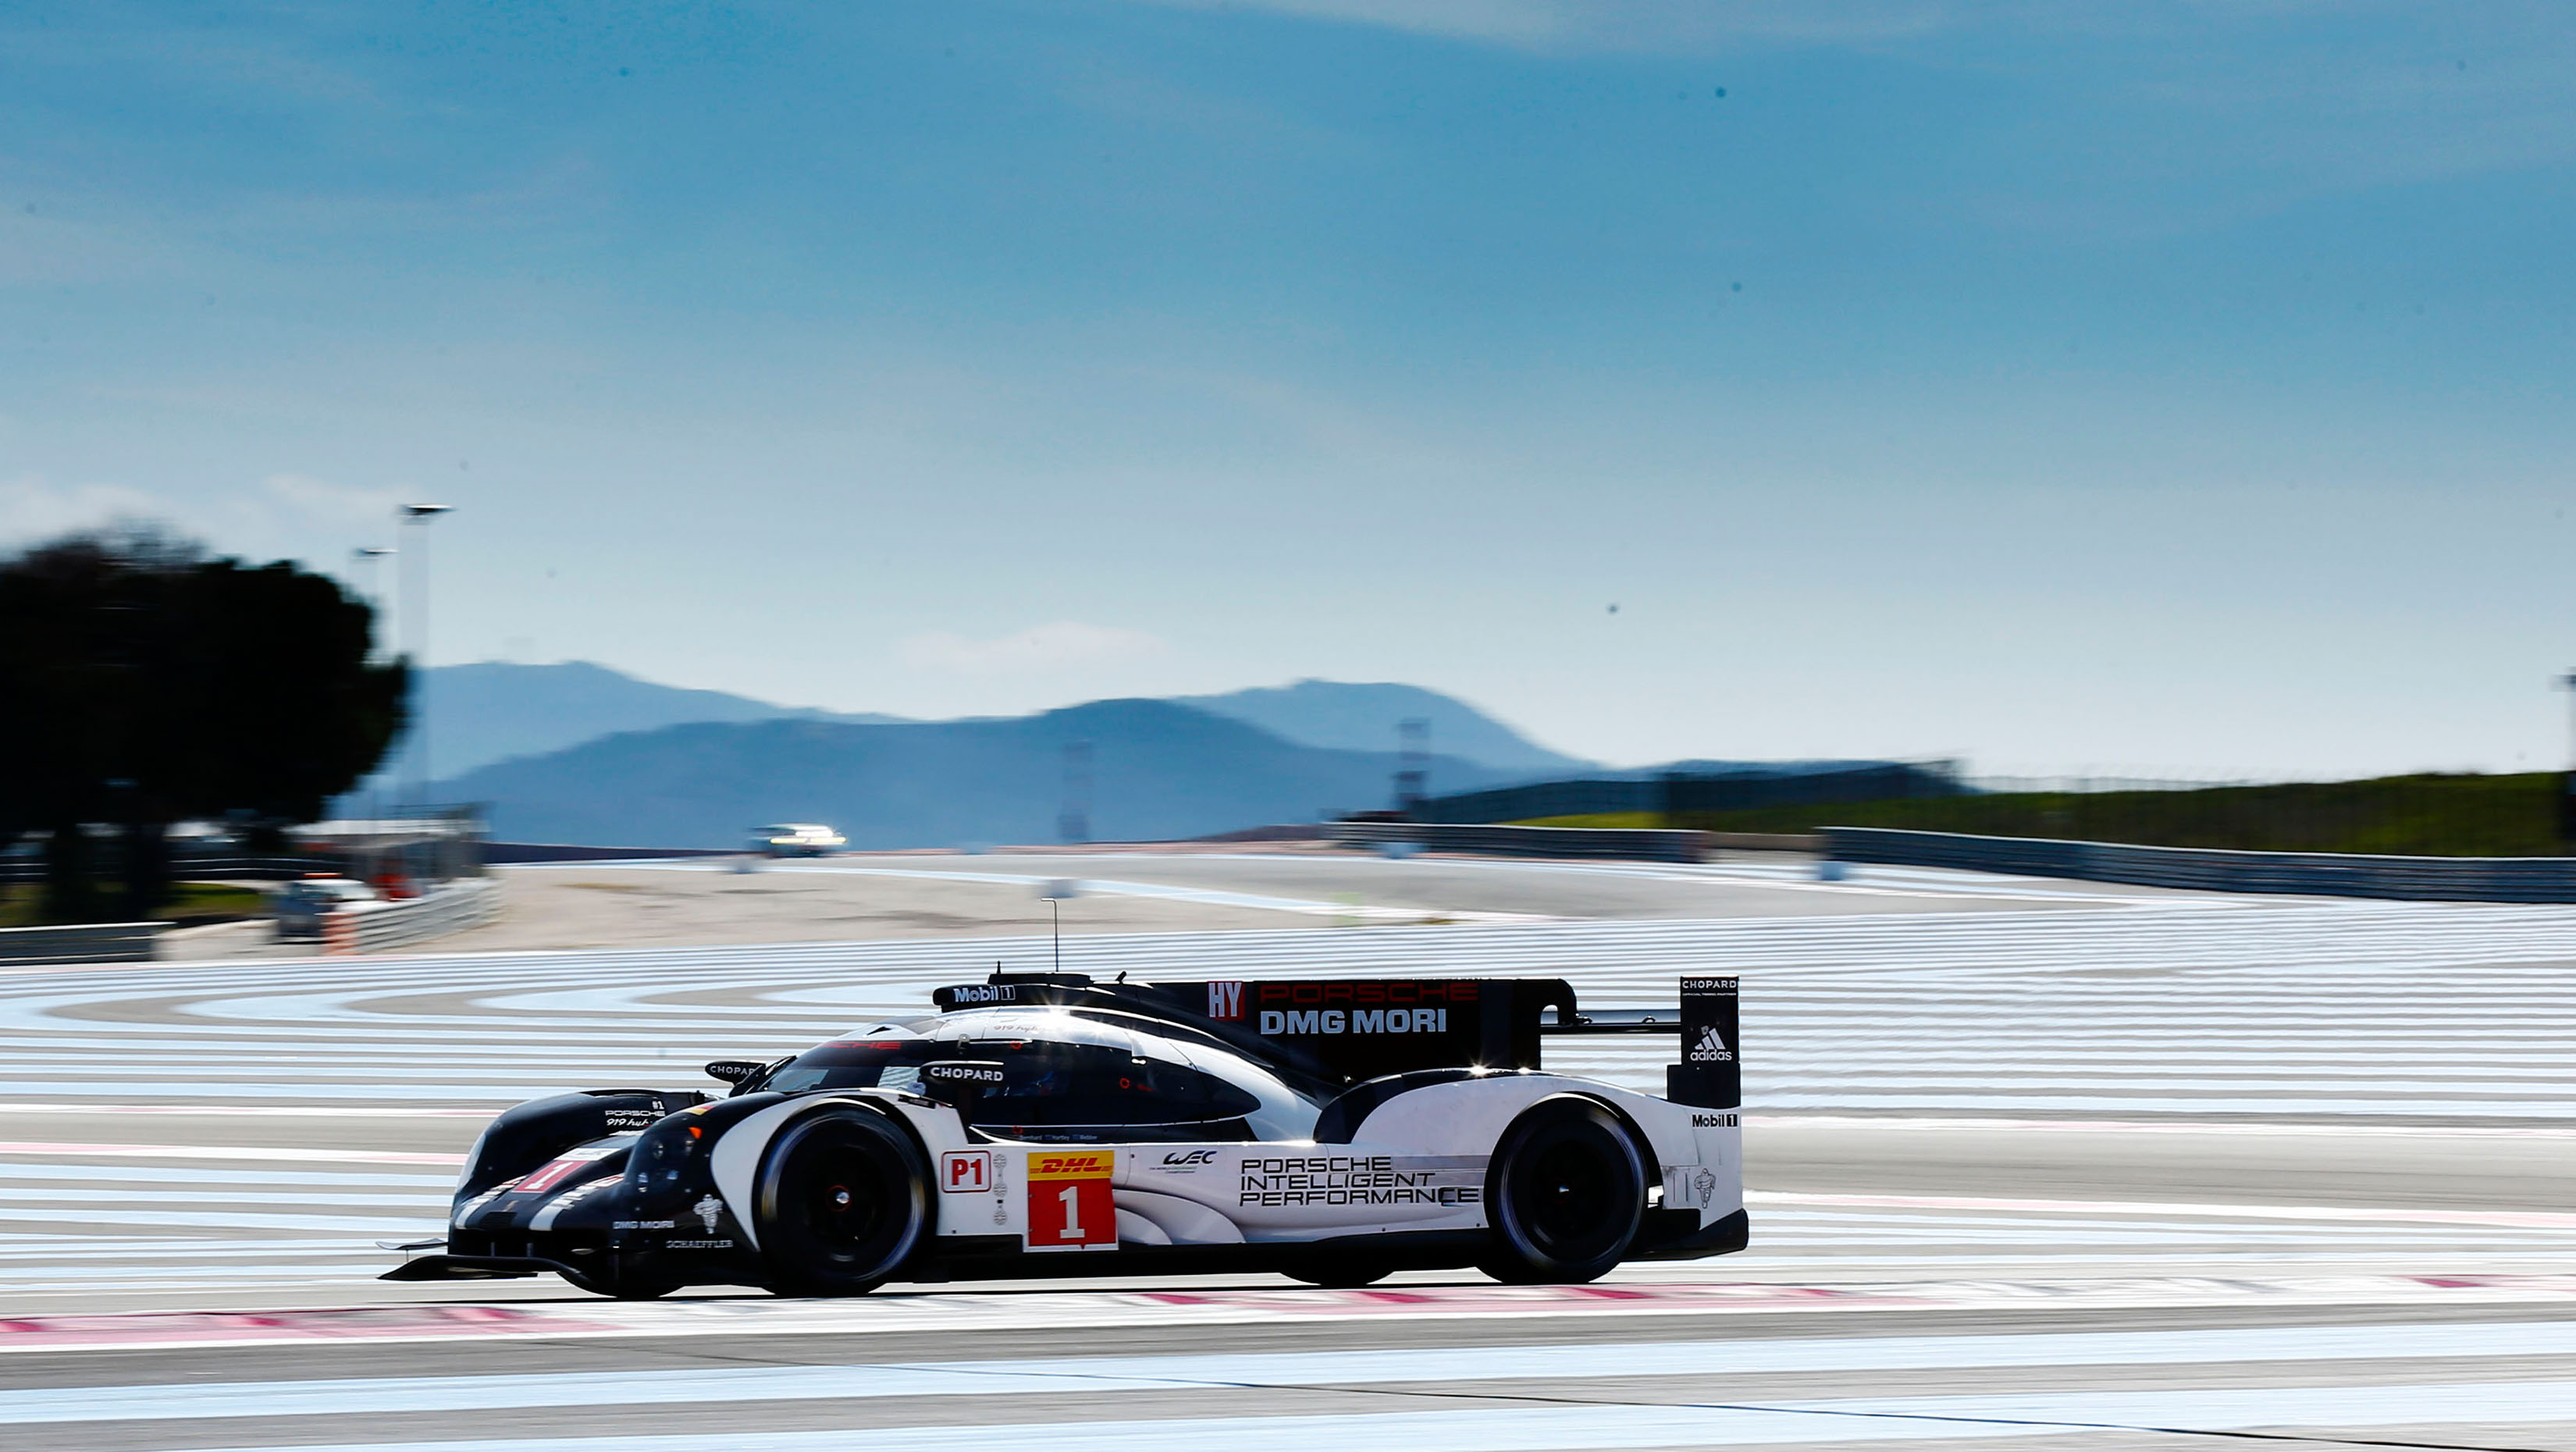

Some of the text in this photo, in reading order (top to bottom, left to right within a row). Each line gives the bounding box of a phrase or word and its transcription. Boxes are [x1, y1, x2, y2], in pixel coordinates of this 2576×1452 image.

[1682, 980, 1737, 989] CHOPARD
[953, 986, 999, 1002] Mobil
[1208, 982, 1242, 1018] HY
[1260, 983, 1479, 1004] PORSCHE
[1261, 1009, 1447, 1035] DMG MORI
[1690, 1048, 1732, 1062] adidas
[930, 1066, 1004, 1082] CHOPARD
[1692, 1114, 1725, 1127] Mobil
[1041, 1158, 1102, 1173] DHL
[1163, 1150, 1218, 1165] WEC
[1242, 1156, 1392, 1174] PORSCHE
[525, 1162, 574, 1190] 1
[951, 1158, 983, 1186] P1
[1241, 1173, 1436, 1191] INTELLIGENT
[1240, 1187, 1480, 1207] PERFORMANCE
[1059, 1186, 1085, 1239] 1
[639, 1220, 675, 1229] MORI
[666, 1240, 734, 1248] SCHAEFFLER
